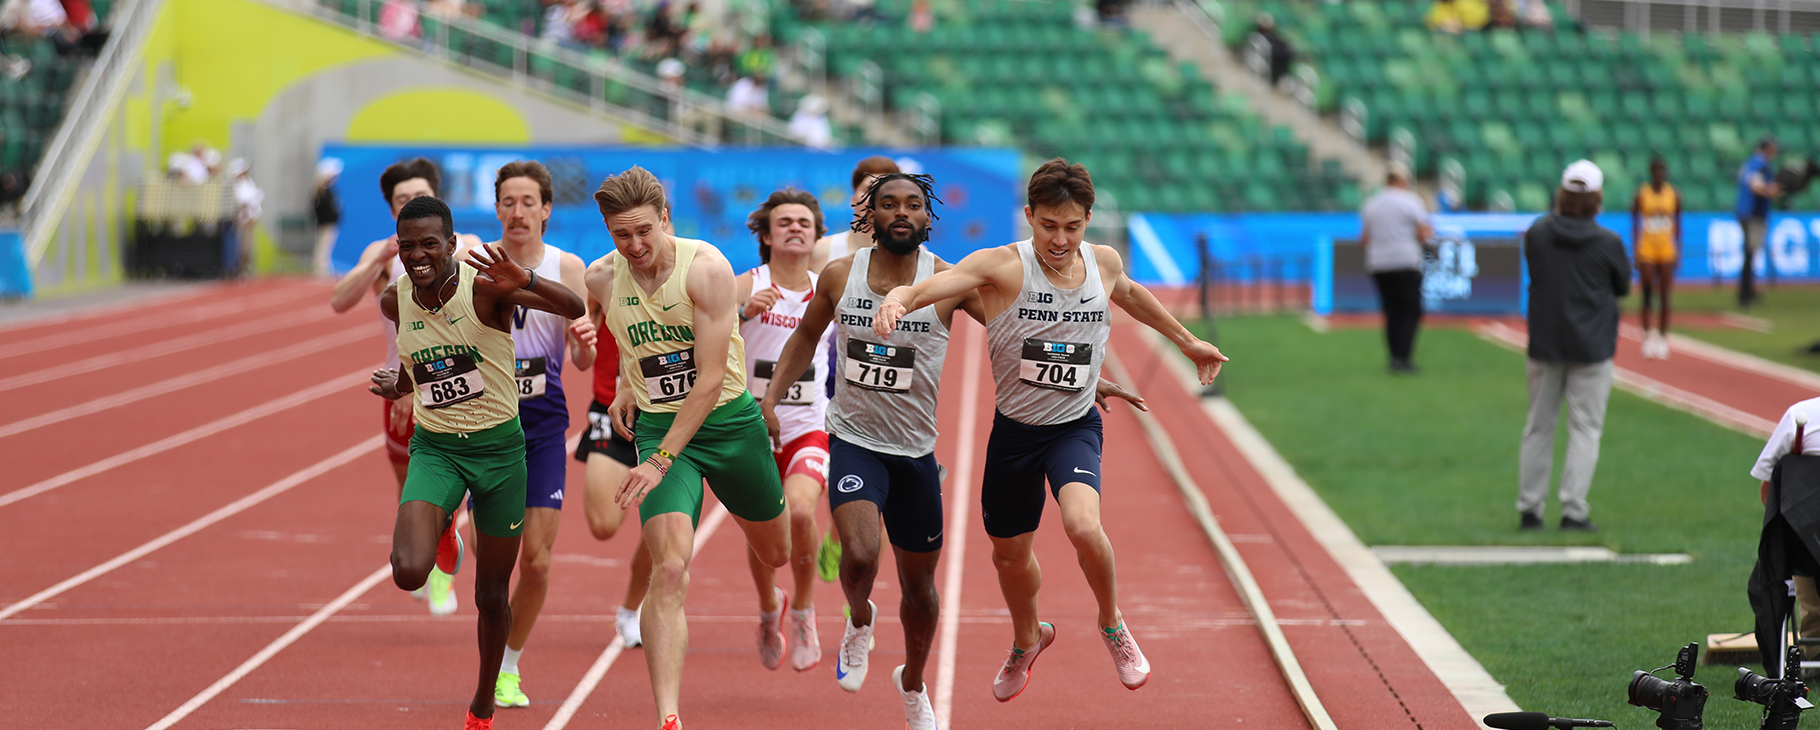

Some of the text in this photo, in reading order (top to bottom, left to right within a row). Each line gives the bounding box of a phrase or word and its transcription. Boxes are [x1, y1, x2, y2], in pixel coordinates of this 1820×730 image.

[895, 319, 931, 333] TATE
[1018, 308, 1104, 322] PENN STATE
[659, 370, 697, 396] 676
[858, 363, 898, 387] 719
[1036, 362, 1077, 386] 704
[430, 376, 470, 403] 683
